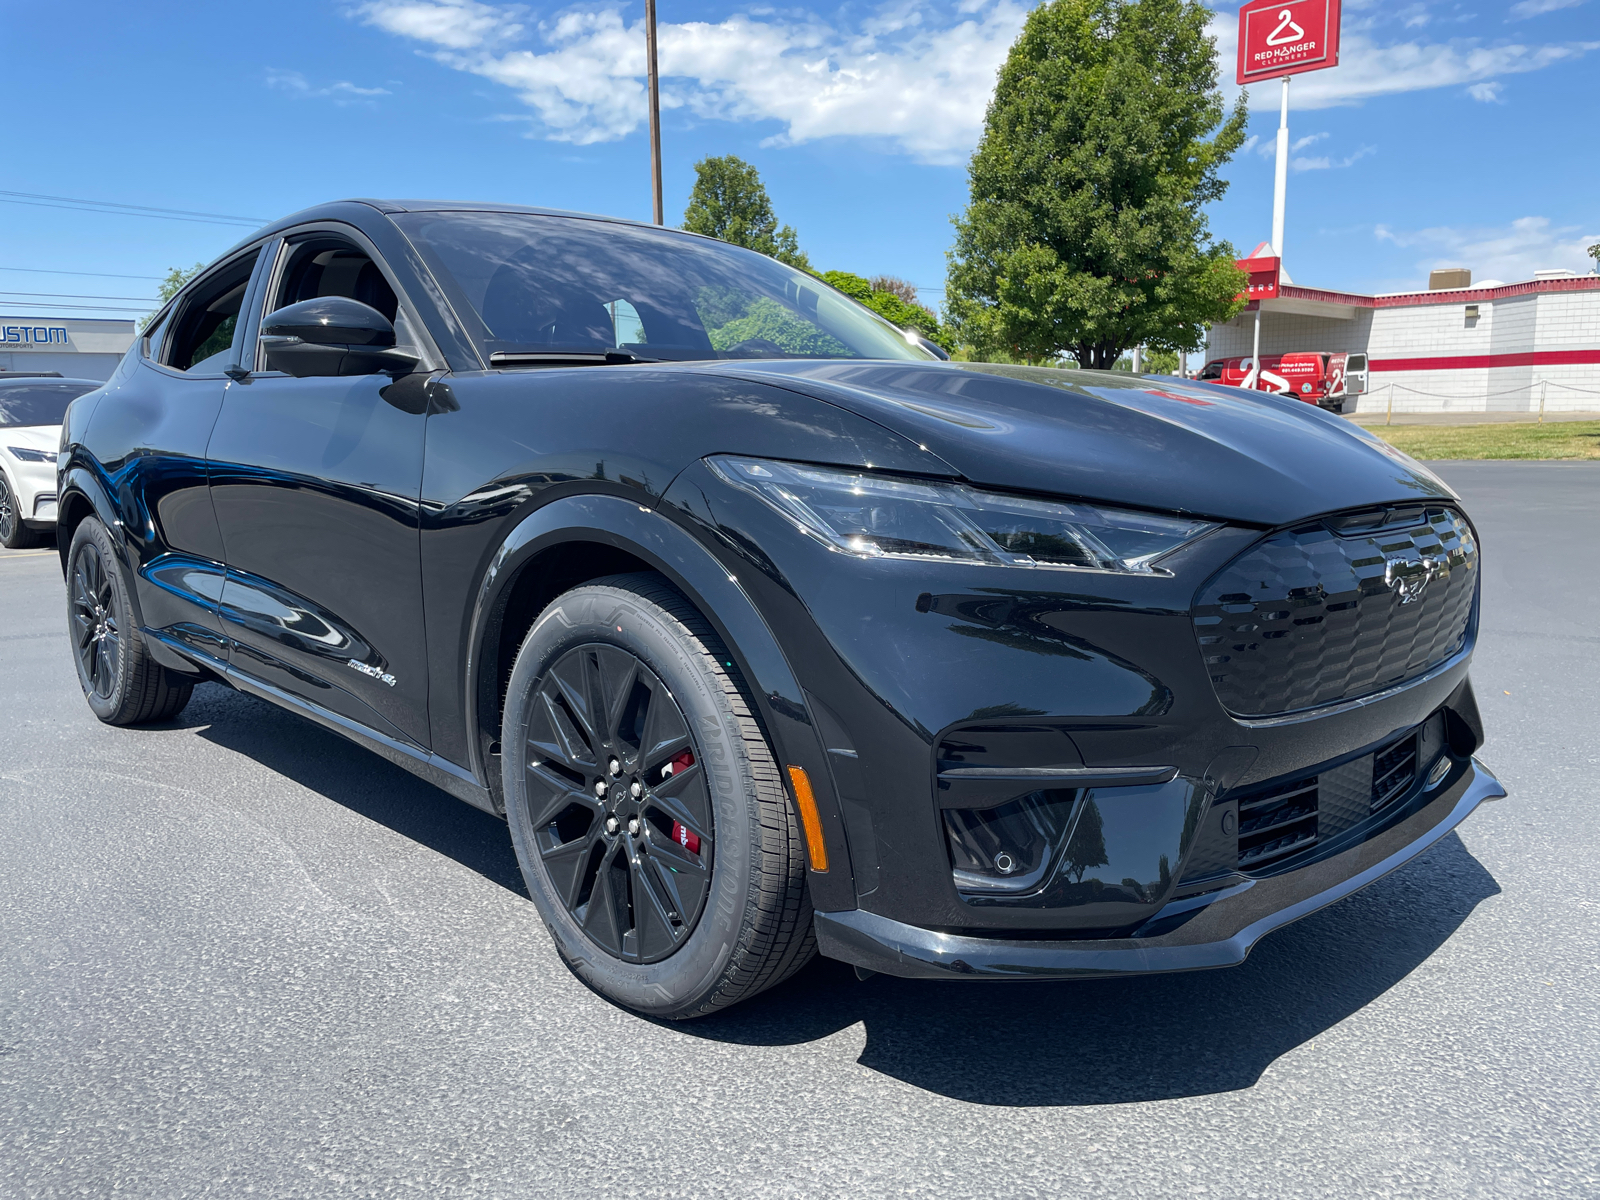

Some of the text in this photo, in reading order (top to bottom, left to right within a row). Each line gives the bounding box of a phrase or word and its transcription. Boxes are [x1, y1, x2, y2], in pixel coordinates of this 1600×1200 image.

[1254, 41, 1316, 61] RED HANGER
[1262, 52, 1307, 66] CLEANERS
[695, 714, 740, 933] BRIDGESTONE
